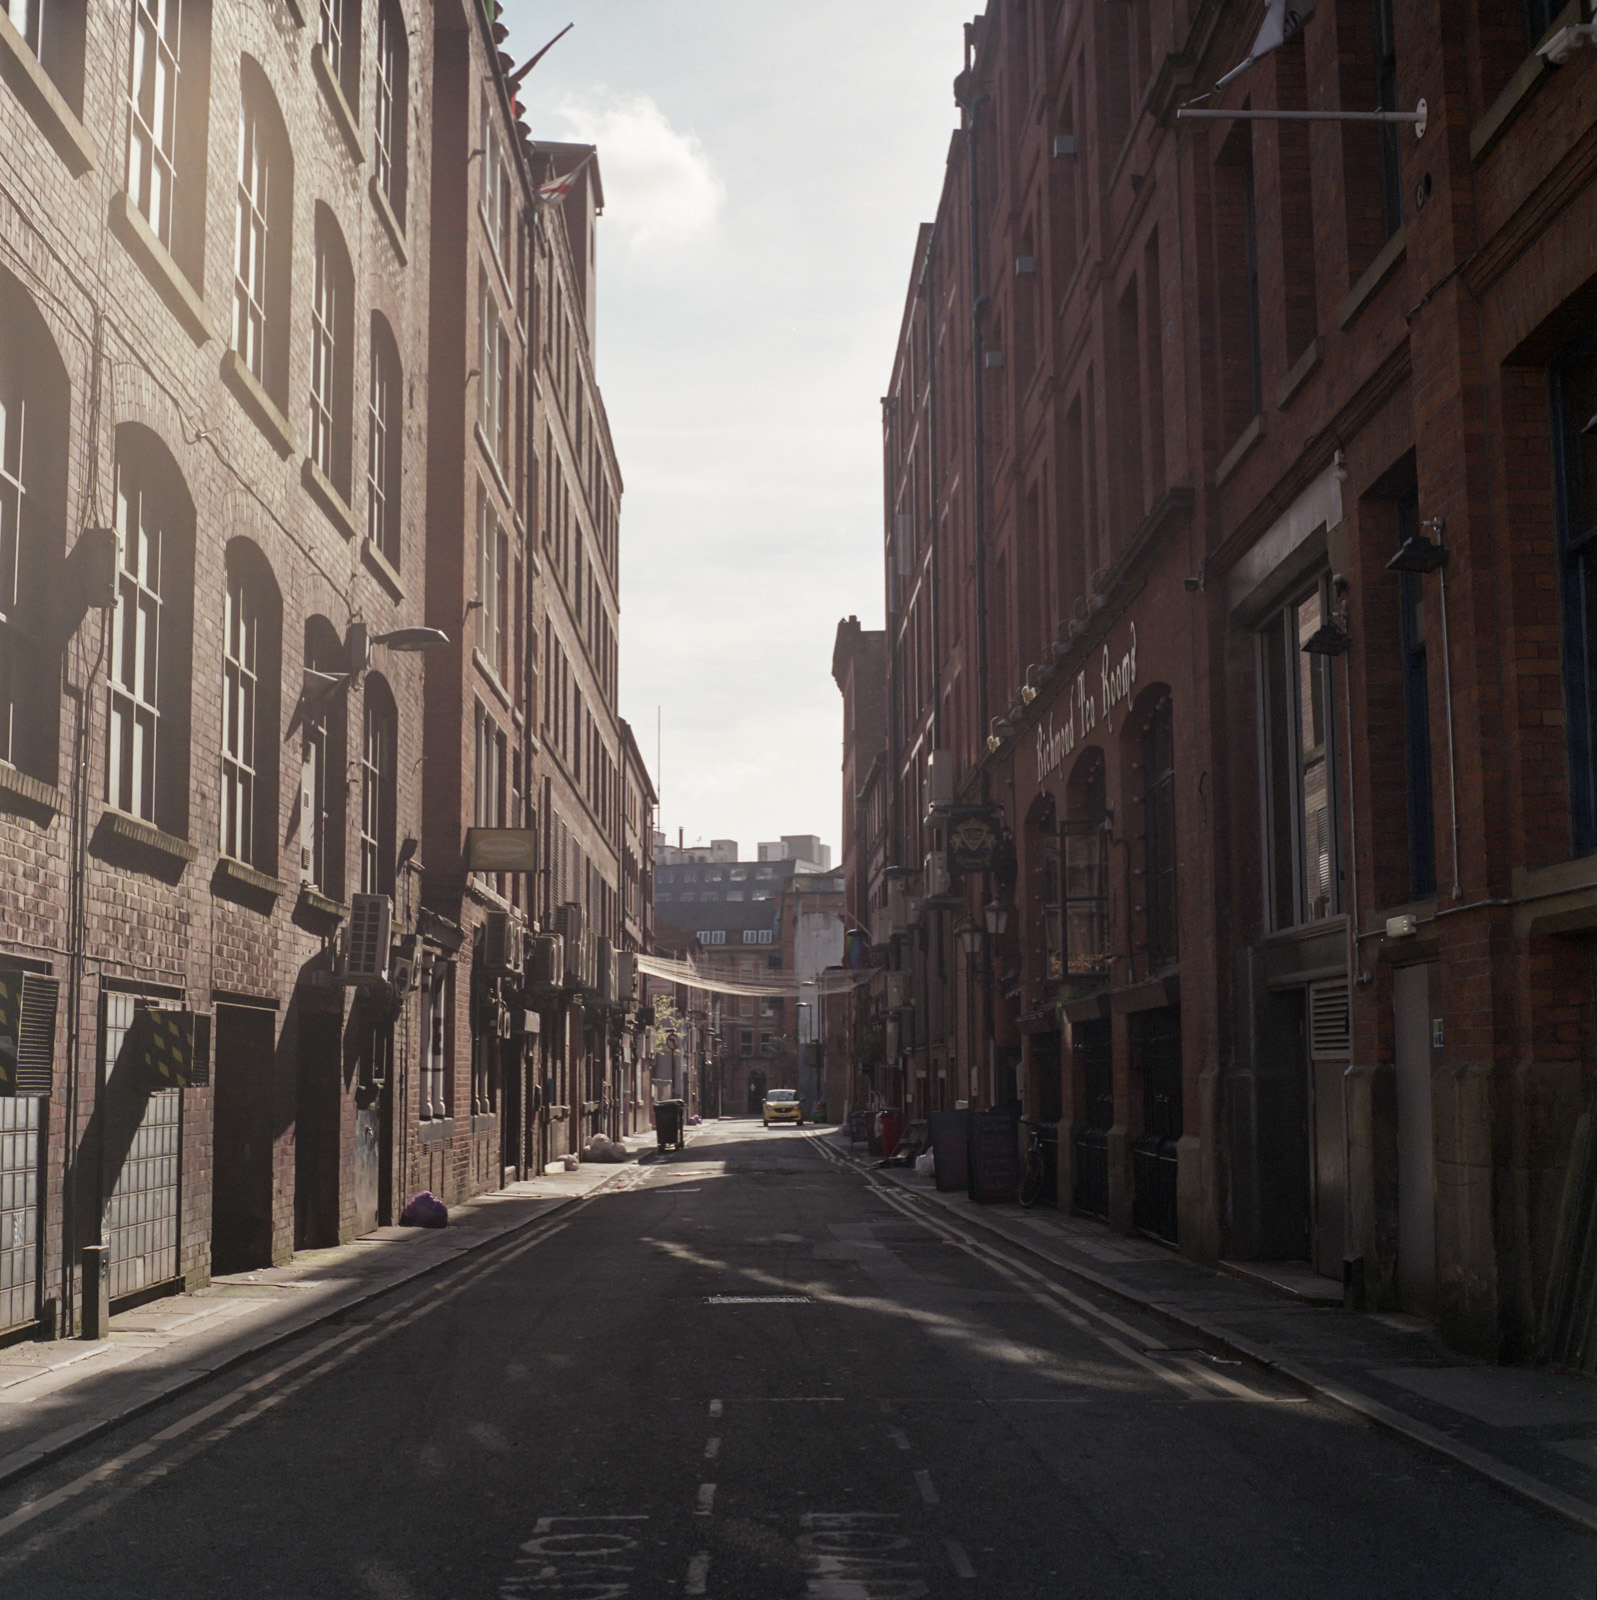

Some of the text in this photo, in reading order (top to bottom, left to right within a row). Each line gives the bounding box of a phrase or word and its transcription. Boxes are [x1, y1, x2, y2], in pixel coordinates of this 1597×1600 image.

[1037, 621, 1136, 797] Richmond Tea Rooms
